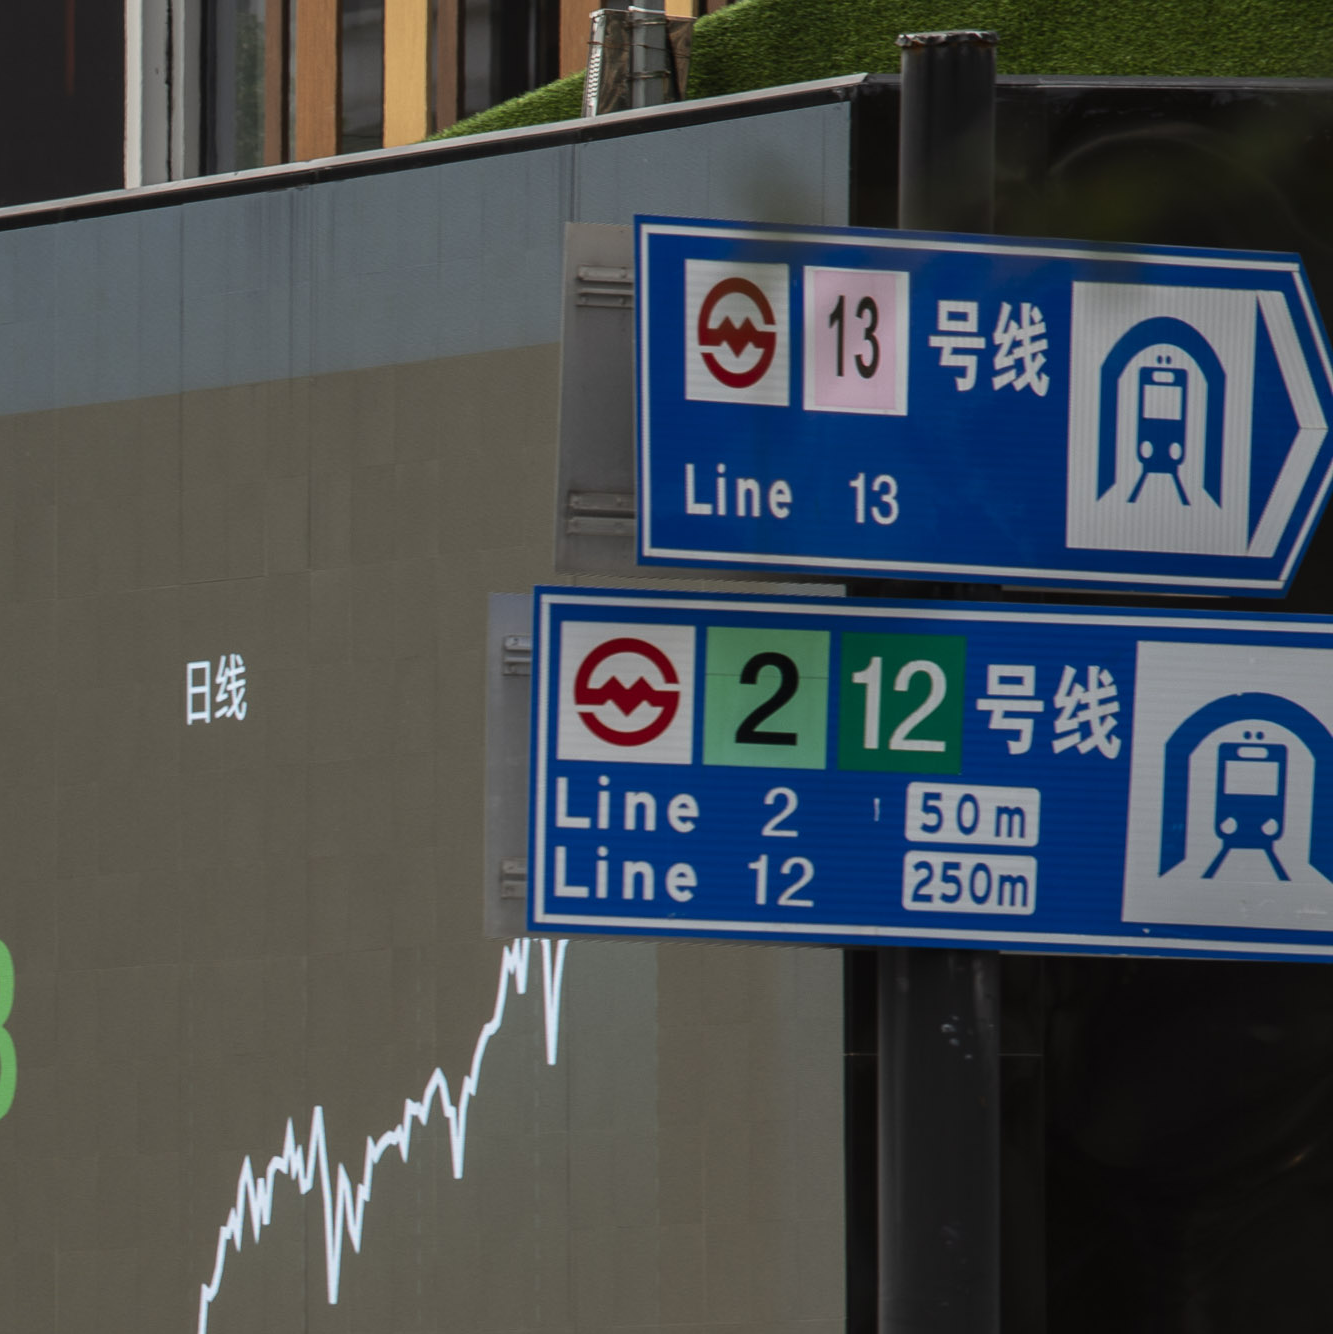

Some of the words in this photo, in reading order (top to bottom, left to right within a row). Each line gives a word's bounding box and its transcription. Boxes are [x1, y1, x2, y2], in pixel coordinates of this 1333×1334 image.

[828, 294, 881, 380] 13
[929, 300, 1050, 397] 号线
[685, 463, 793, 519] Line
[848, 473, 900, 526] 13
[185, 652, 248, 726] 日线
[734, 651, 800, 747] 2
[852, 656, 947, 752] 12
[976, 664, 1121, 760] 号线
[555, 776, 700, 833] Line
[762, 787, 799, 838] 2
[553, 846, 699, 902] Line
[747, 854, 816, 908] 12
[910, 861, 1030, 908] 250m
